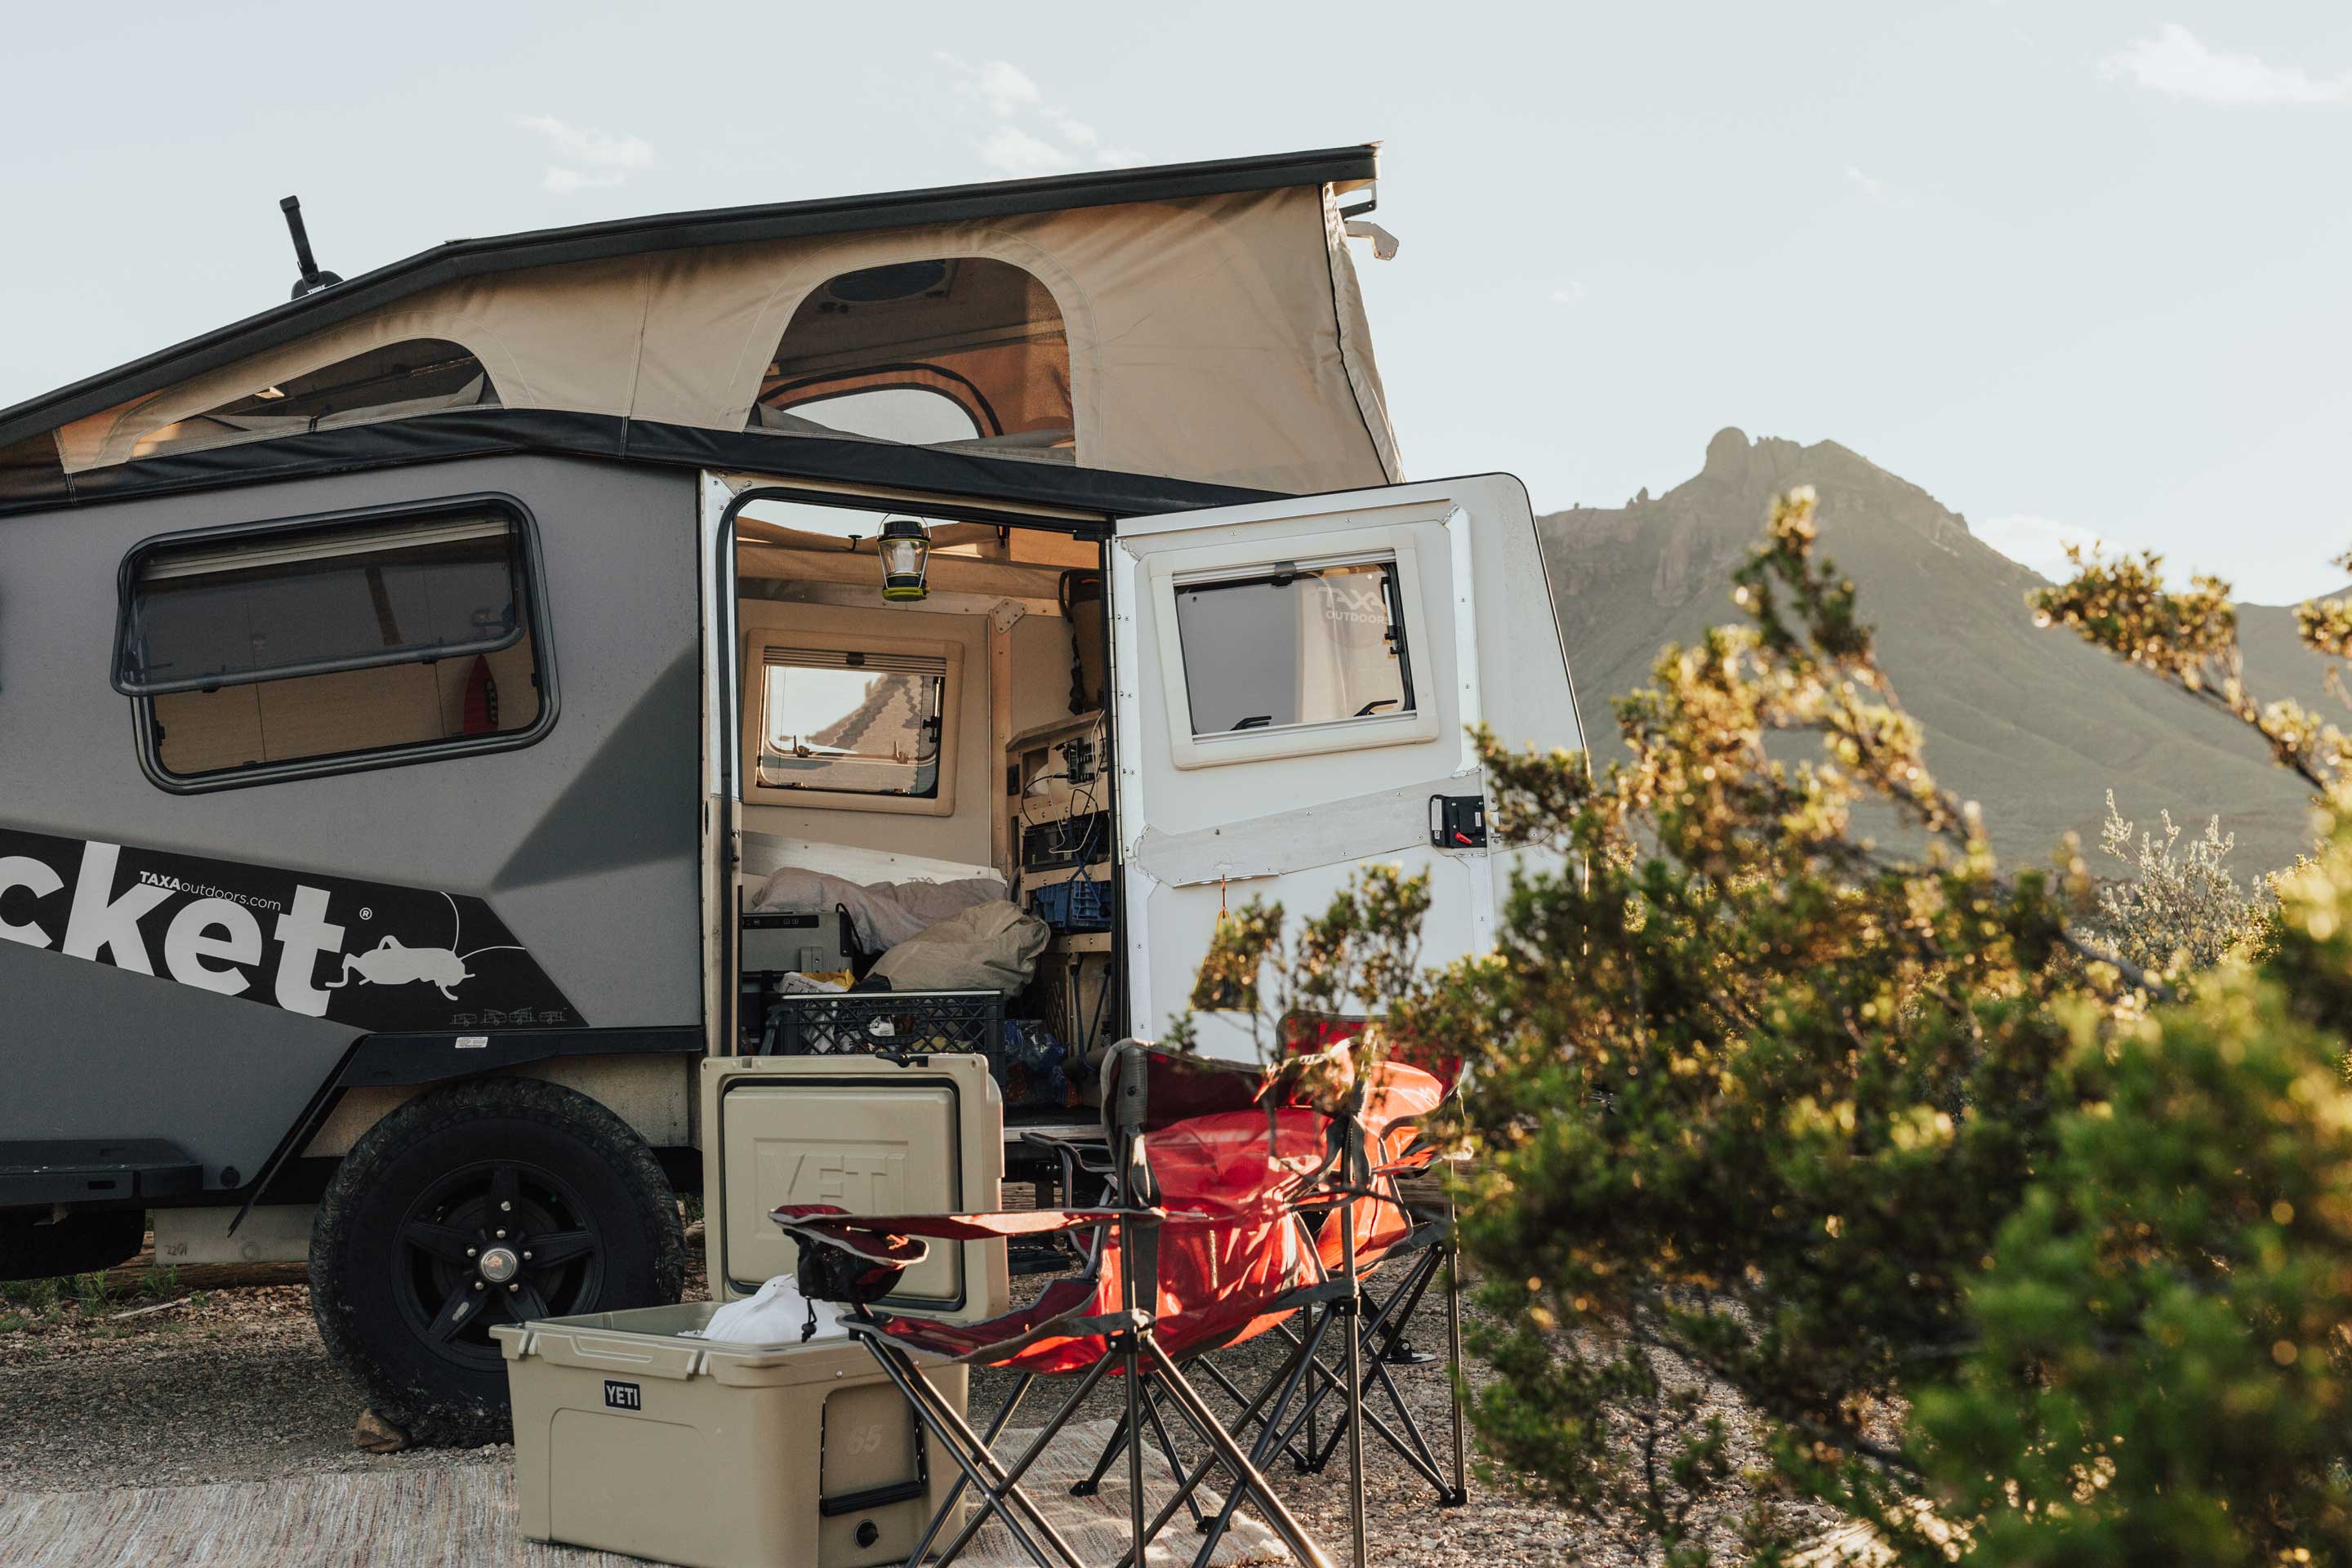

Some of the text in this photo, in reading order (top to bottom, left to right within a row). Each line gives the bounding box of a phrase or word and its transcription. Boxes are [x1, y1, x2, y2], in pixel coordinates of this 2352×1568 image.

[140, 871, 281, 911] TAXAoutdoors.com
[606, 1384, 638, 1406] YETI
[848, 1424, 883, 1455] 65
